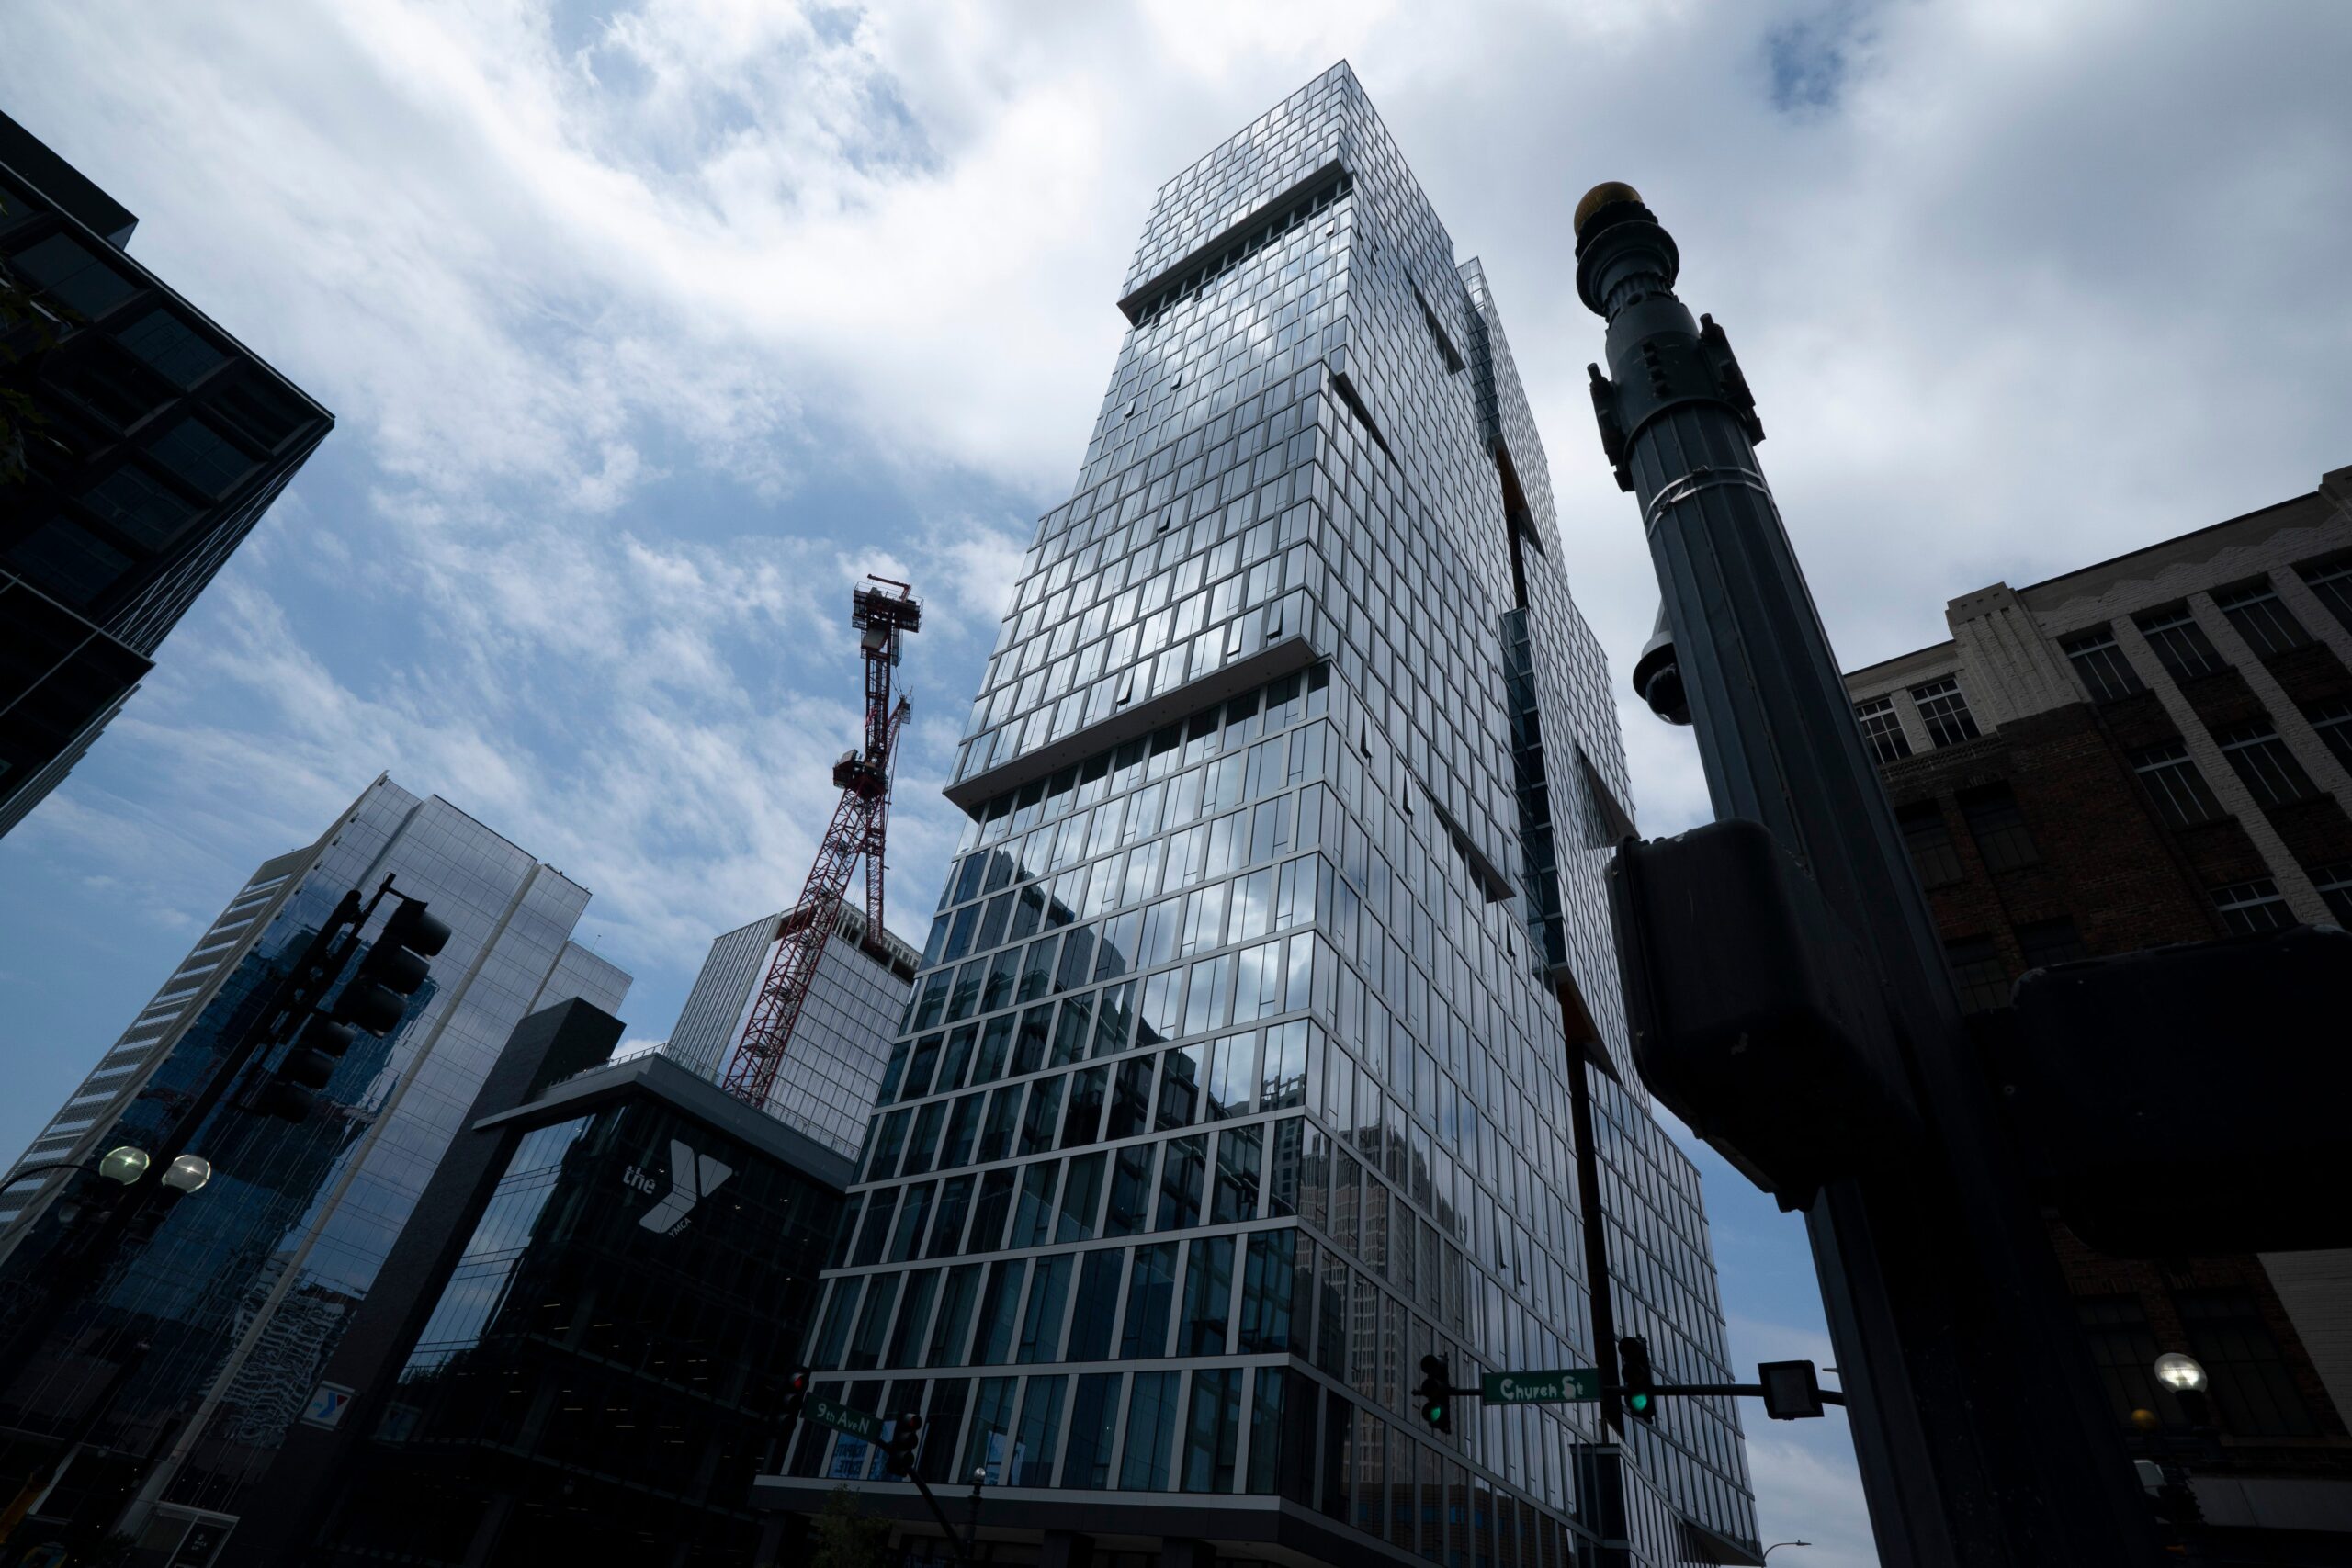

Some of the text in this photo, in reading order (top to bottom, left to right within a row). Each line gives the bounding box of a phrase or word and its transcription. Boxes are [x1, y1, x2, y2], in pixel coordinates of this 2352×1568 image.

[623, 1165, 656, 1194] the
[668, 1217, 692, 1238] YMCA
[1500, 1375, 1583, 1401] Church St
[816, 1403, 870, 1435] 9th Ave N
